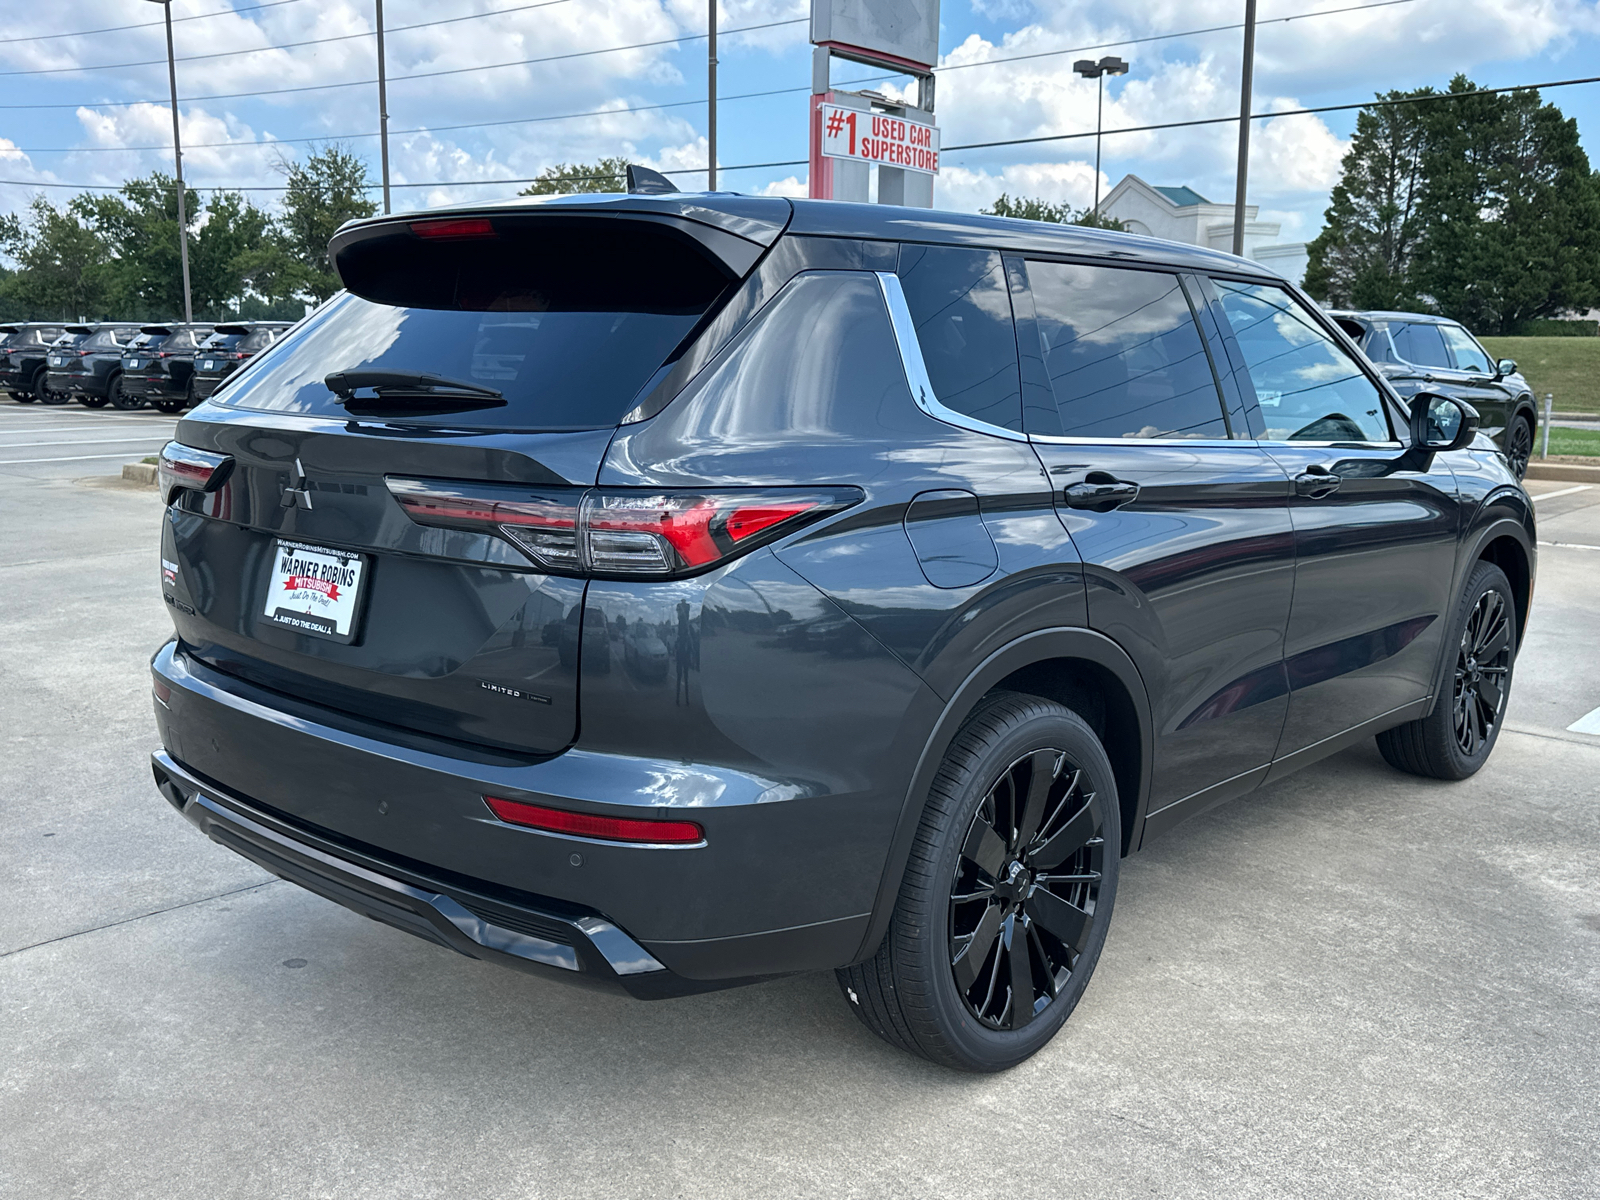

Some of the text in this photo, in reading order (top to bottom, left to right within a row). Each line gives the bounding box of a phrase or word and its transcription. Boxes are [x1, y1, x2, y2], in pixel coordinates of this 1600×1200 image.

[826, 109, 856, 155] #1
[872, 116, 931, 148] USED CAR
[861, 137, 938, 171] SUPERSTORE
[280, 556, 355, 587] WARNER ROBINS
[294, 577, 333, 593] MITSUBISHI
[279, 616, 292, 626] JUST
[291, 618, 299, 626] DO
[299, 620, 311, 629] THE
[481, 682, 520, 697] LIMITED
